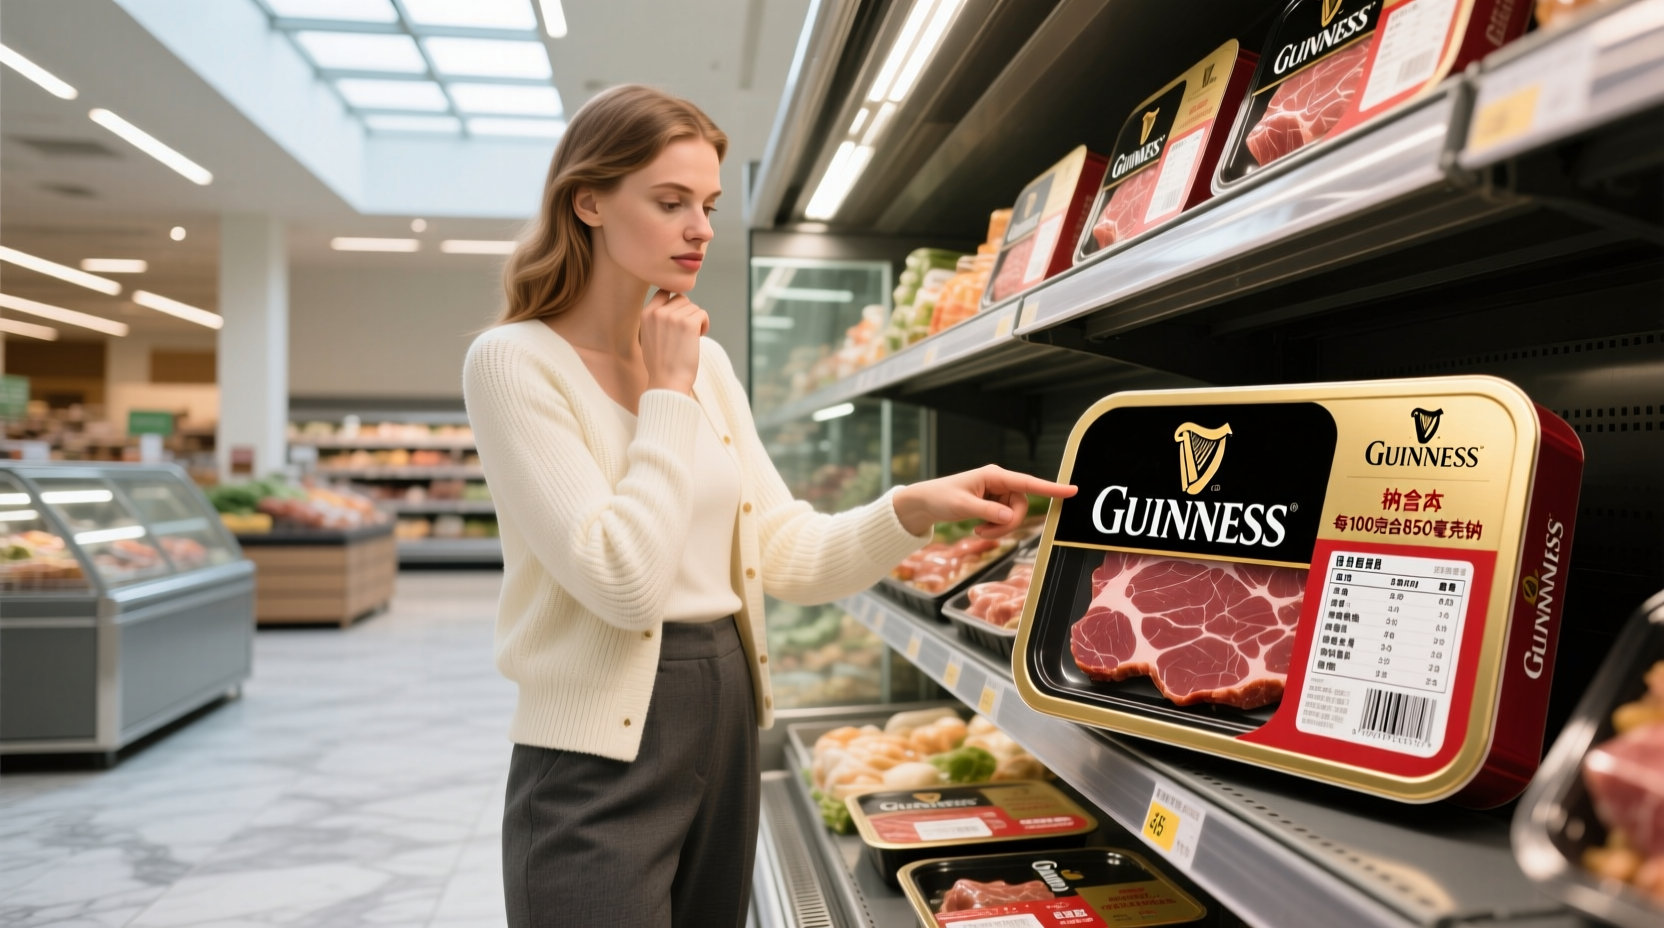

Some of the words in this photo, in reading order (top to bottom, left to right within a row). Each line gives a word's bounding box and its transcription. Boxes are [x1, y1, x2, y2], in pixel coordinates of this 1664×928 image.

[1273, 9, 1371, 75] GUINNESS
[1365, 440, 1479, 468] GUINNESS
[1092, 485, 1288, 548] GUINNESS
